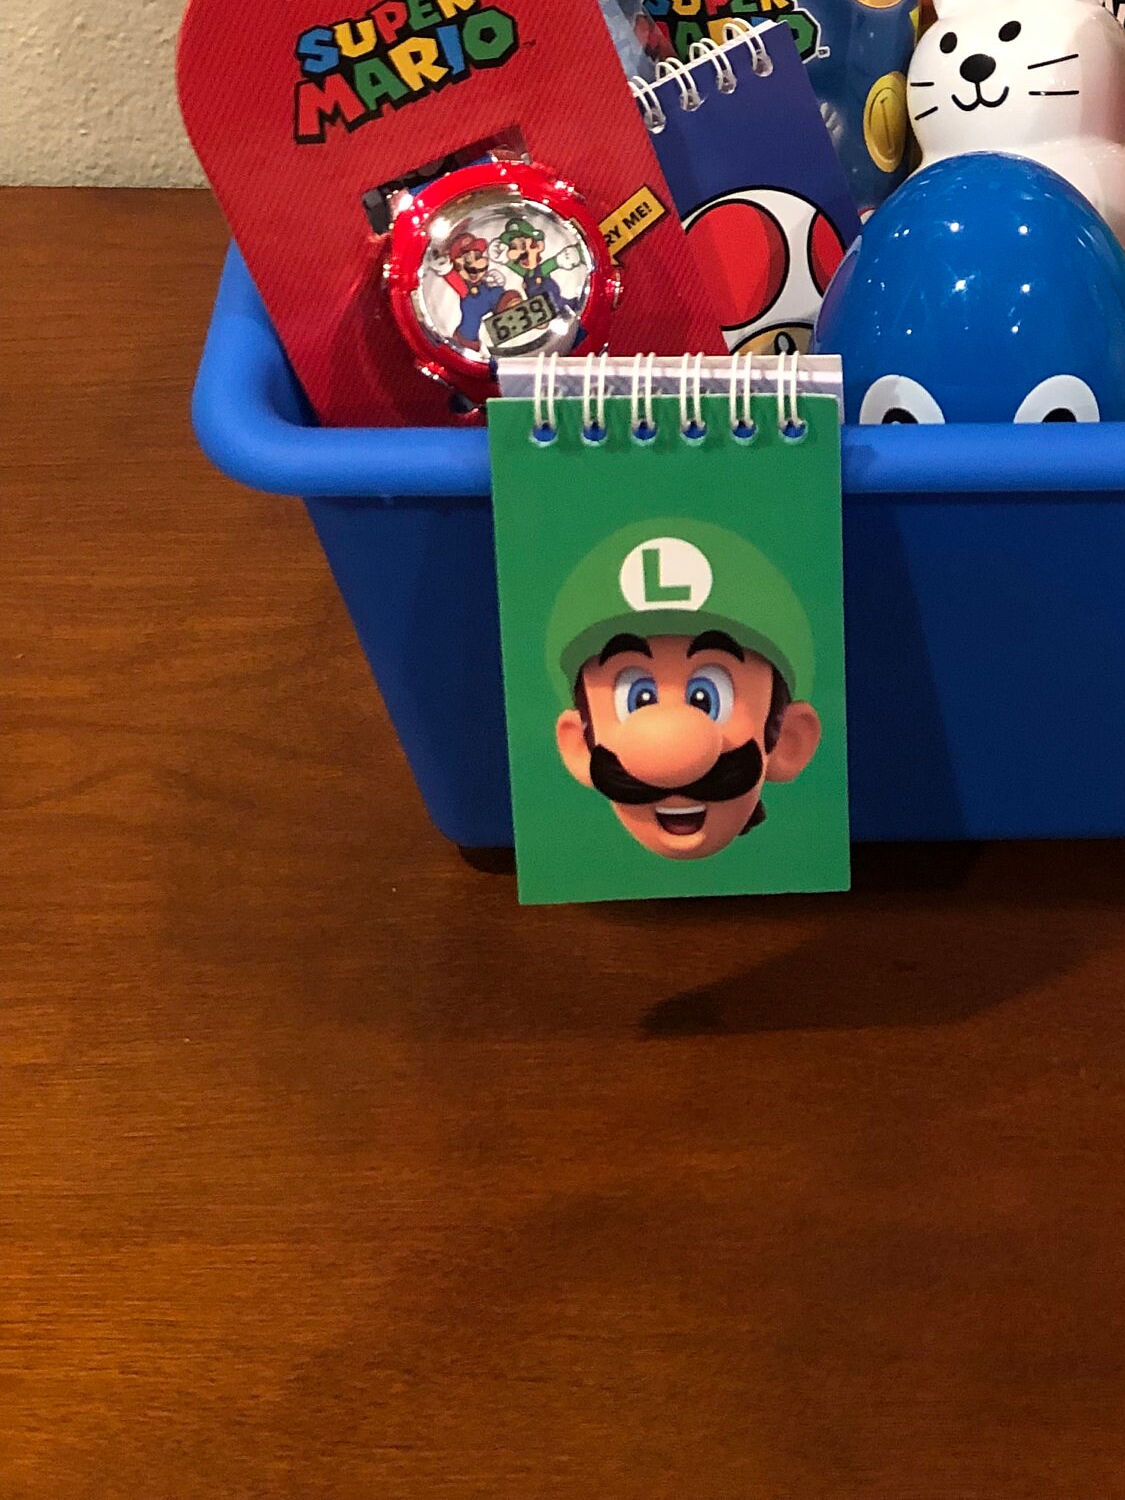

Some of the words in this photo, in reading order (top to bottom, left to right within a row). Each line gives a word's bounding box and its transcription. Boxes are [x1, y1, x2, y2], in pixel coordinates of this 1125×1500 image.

[294, 6, 520, 144] MARIO
[603, 225, 623, 247] RY
[622, 201, 653, 230] ME!
[492, 300, 548, 340] 6:39
[641, 547, 692, 602] L
